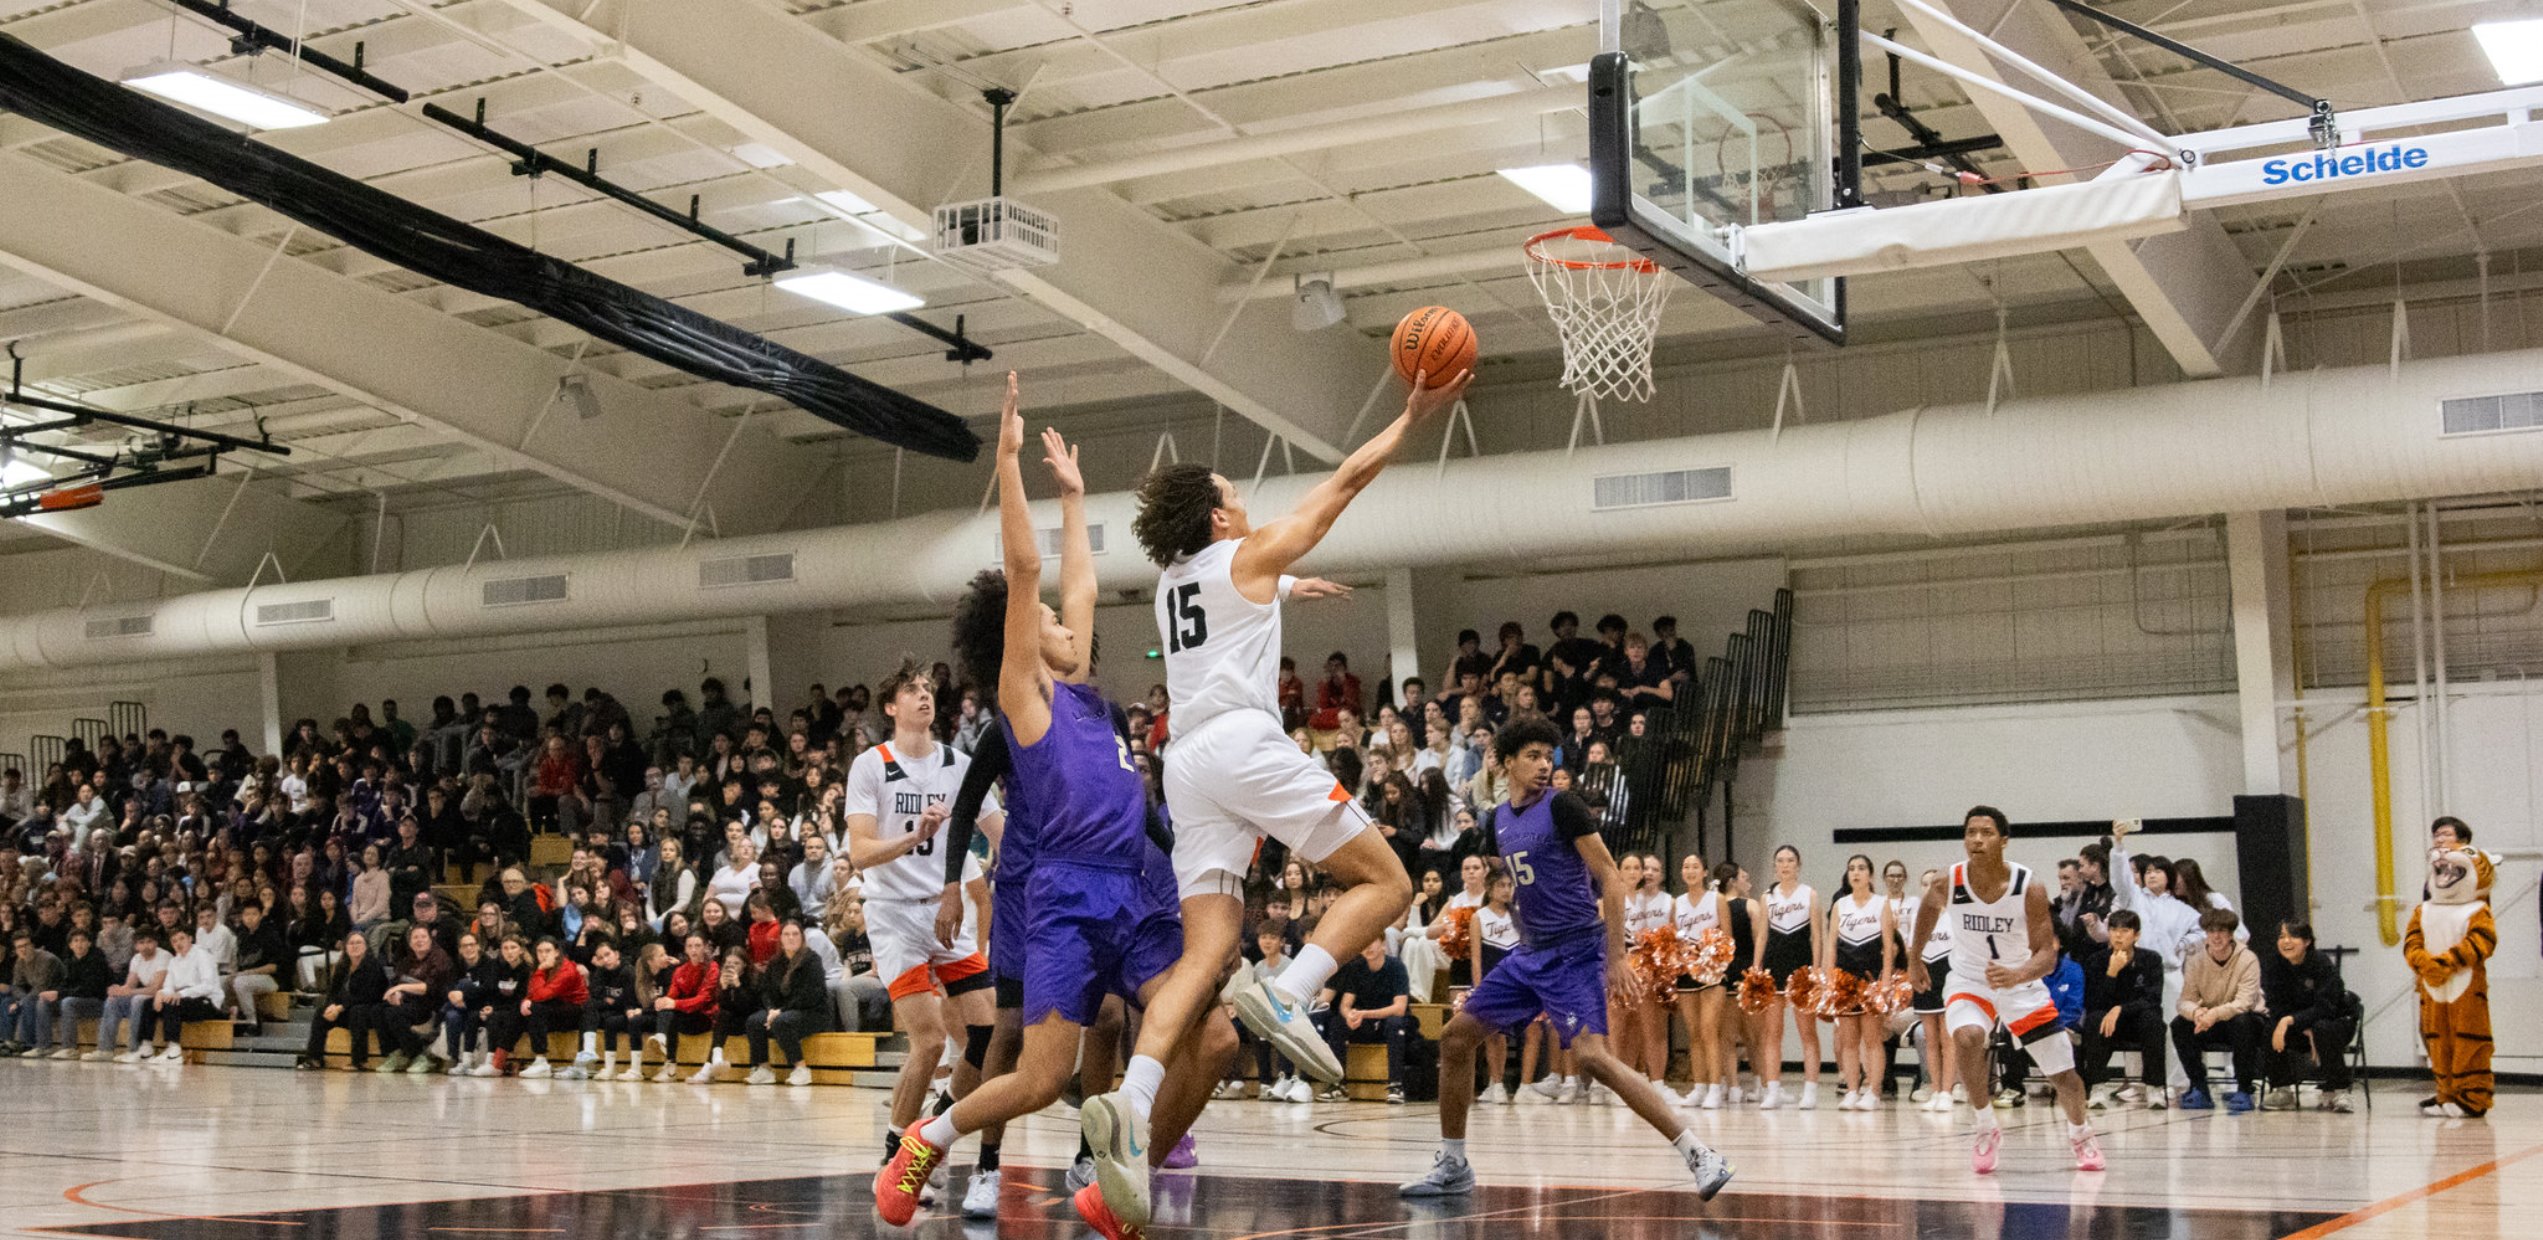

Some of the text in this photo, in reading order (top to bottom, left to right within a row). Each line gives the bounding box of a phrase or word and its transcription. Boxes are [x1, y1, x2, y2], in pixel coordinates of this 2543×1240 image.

[2262, 145, 2429, 185] Schelde
[1404, 307, 1439, 351] Wilson
[1167, 581, 1208, 655] 15
[895, 792, 946, 815] RIDLEY
[1505, 850, 1535, 887] 15
[1678, 913, 1713, 930] Tigers
[1769, 902, 1805, 920] Tigers
[1840, 913, 1878, 931] Tigers
[1963, 913, 2015, 933] RIDLEY
[1986, 934, 2000, 960] 1
